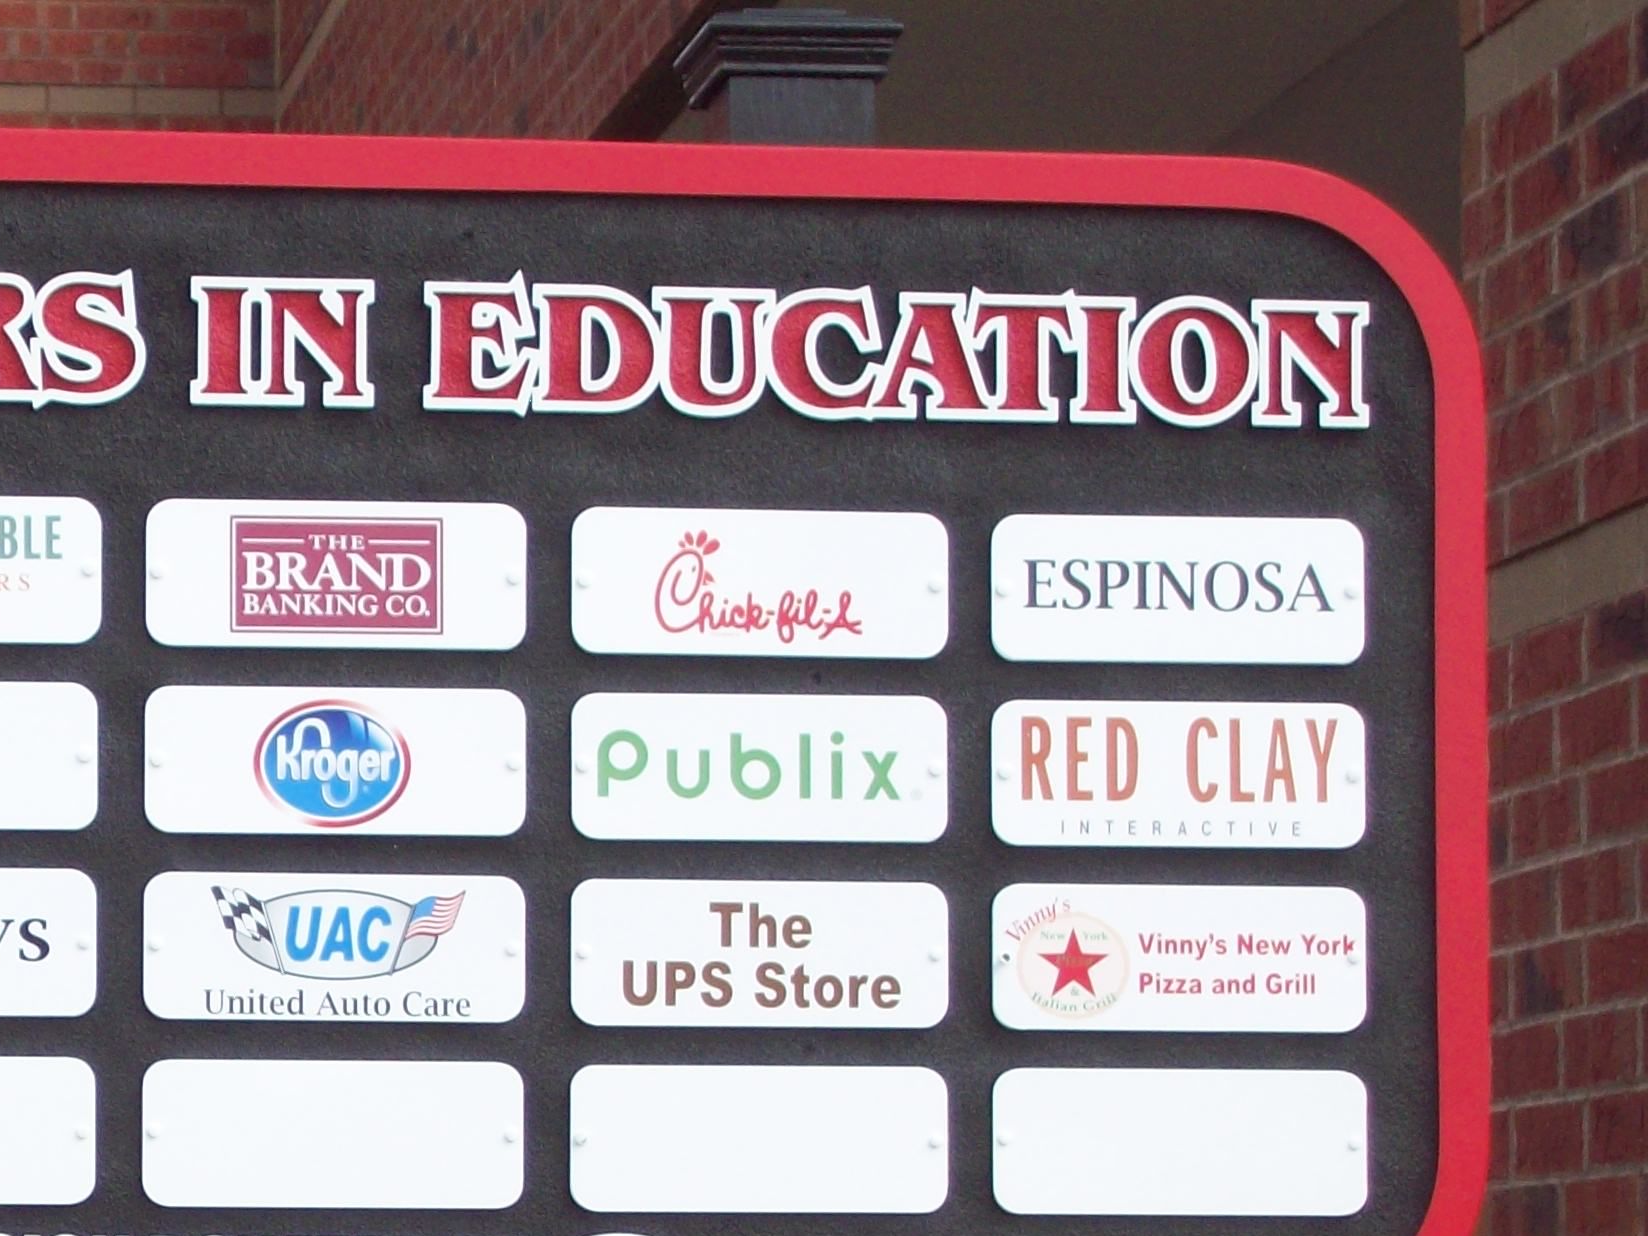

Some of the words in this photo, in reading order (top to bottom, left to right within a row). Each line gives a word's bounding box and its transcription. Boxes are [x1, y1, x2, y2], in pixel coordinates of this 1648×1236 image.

[189, 274, 376, 412] IN
[422, 272, 1374, 432] EDUCATION
[308, 534, 366, 551] THE
[241, 551, 432, 592] BRAND
[1023, 559, 1335, 613] ESPINOSA
[242, 593, 380, 616] BANKING
[385, 594, 431, 617] CO.
[655, 548, 863, 644] Chick-fil-A
[275, 716, 396, 807] Kroger
[596, 729, 900, 801] Publix
[1021, 715, 1139, 802] RED
[1186, 716, 1339, 803] CLAY
[1060, 819, 1303, 838] INTERACTIVE
[284, 904, 393, 963] UAC
[708, 901, 813, 949] The
[1004, 896, 1072, 942] Vinny's
[1138, 933, 1228, 960] Vinny's
[1237, 934, 1292, 956] New
[1298, 934, 1355, 957] York
[203, 988, 307, 1018] United
[317, 989, 392, 1018] Auto
[400, 990, 472, 1019] Care
[620, 960, 735, 1008] UPS
[754, 961, 902, 1010] Store
[1139, 973, 1202, 995] Pizza
[1212, 973, 1256, 995] and
[1266, 973, 1316, 995] Grill
